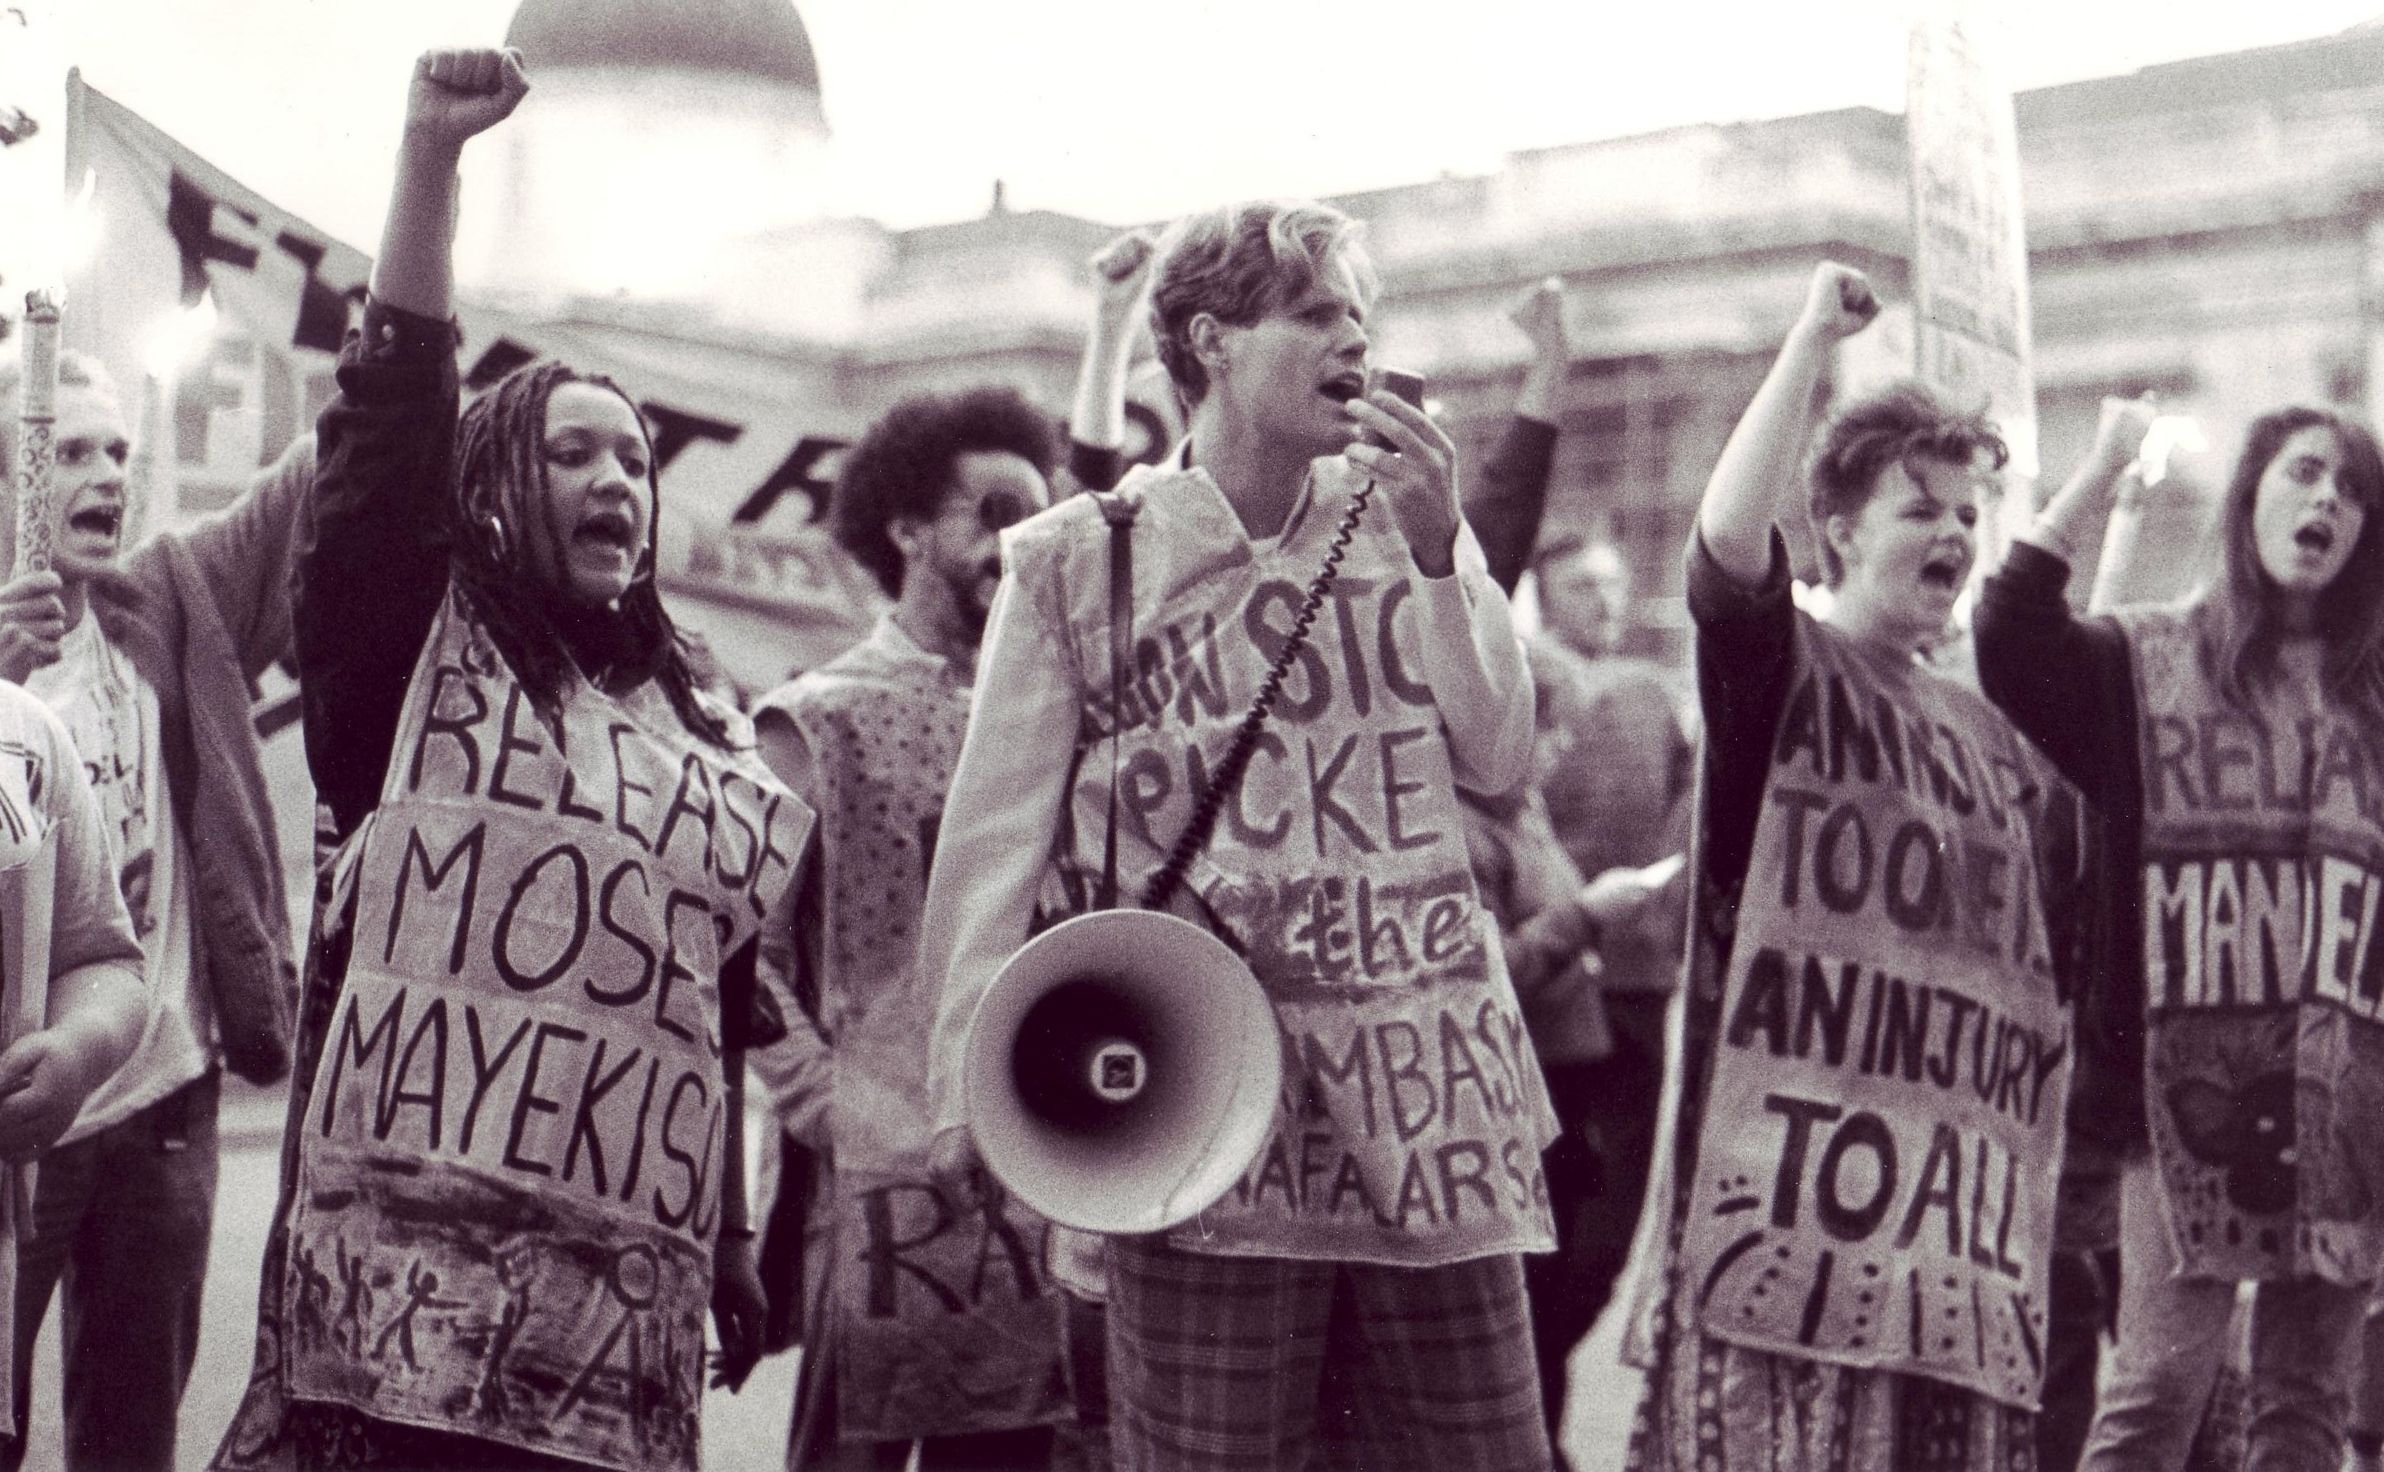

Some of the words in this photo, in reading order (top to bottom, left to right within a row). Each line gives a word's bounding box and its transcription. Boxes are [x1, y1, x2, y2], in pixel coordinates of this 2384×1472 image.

[409, 664, 788, 918] RELEASE
[1777, 666, 1879, 784] AN
[1294, 874, 1472, 980] the
[1772, 787, 1874, 914] TO
[1726, 946, 1861, 1068] AN
[1857, 968, 2068, 1126] INJURY
[1762, 1092, 1898, 1242] TO
[1898, 1122, 2022, 1280] ALL
